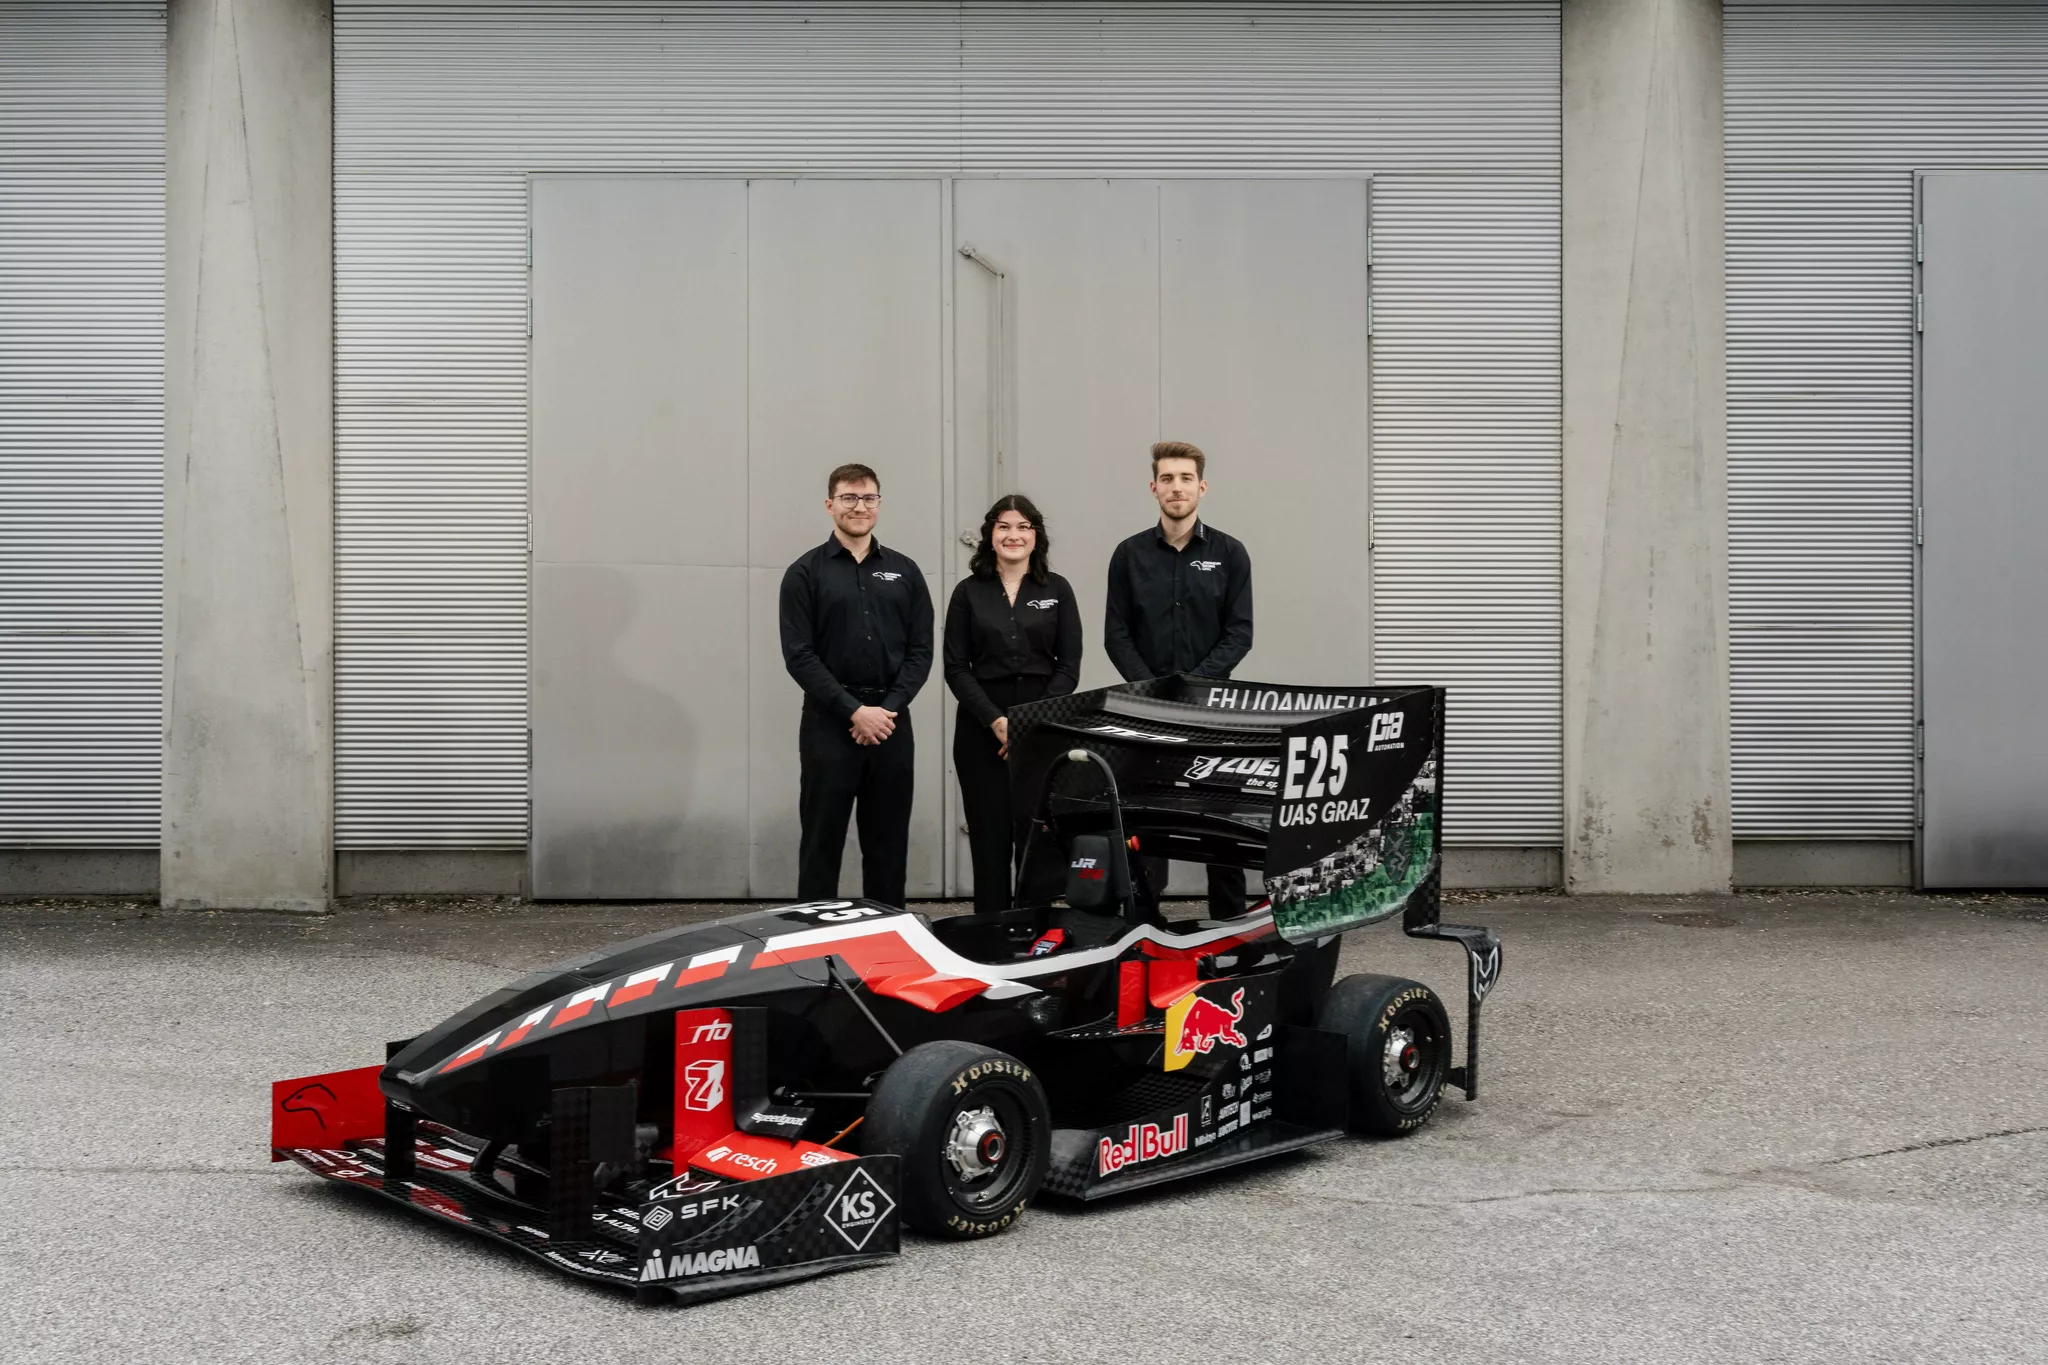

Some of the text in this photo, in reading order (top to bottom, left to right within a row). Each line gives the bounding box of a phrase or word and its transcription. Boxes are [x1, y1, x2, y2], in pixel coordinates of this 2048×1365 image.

[1207, 687, 1239, 708] FH
[1283, 734, 1349, 799] E25
[1246, 778, 1265, 786] the
[1279, 798, 1371, 827] UAS GRAZ
[1071, 857, 1097, 868] JR
[1378, 987, 1429, 1033] Hoosier
[951, 1060, 1031, 1096] Hoosier
[1100, 1113, 1188, 1177] Red Bull
[727, 1151, 777, 1174] resch
[681, 1194, 740, 1219] SFK
[841, 1190, 876, 1222] KS
[668, 1245, 760, 1278] MAGNA
